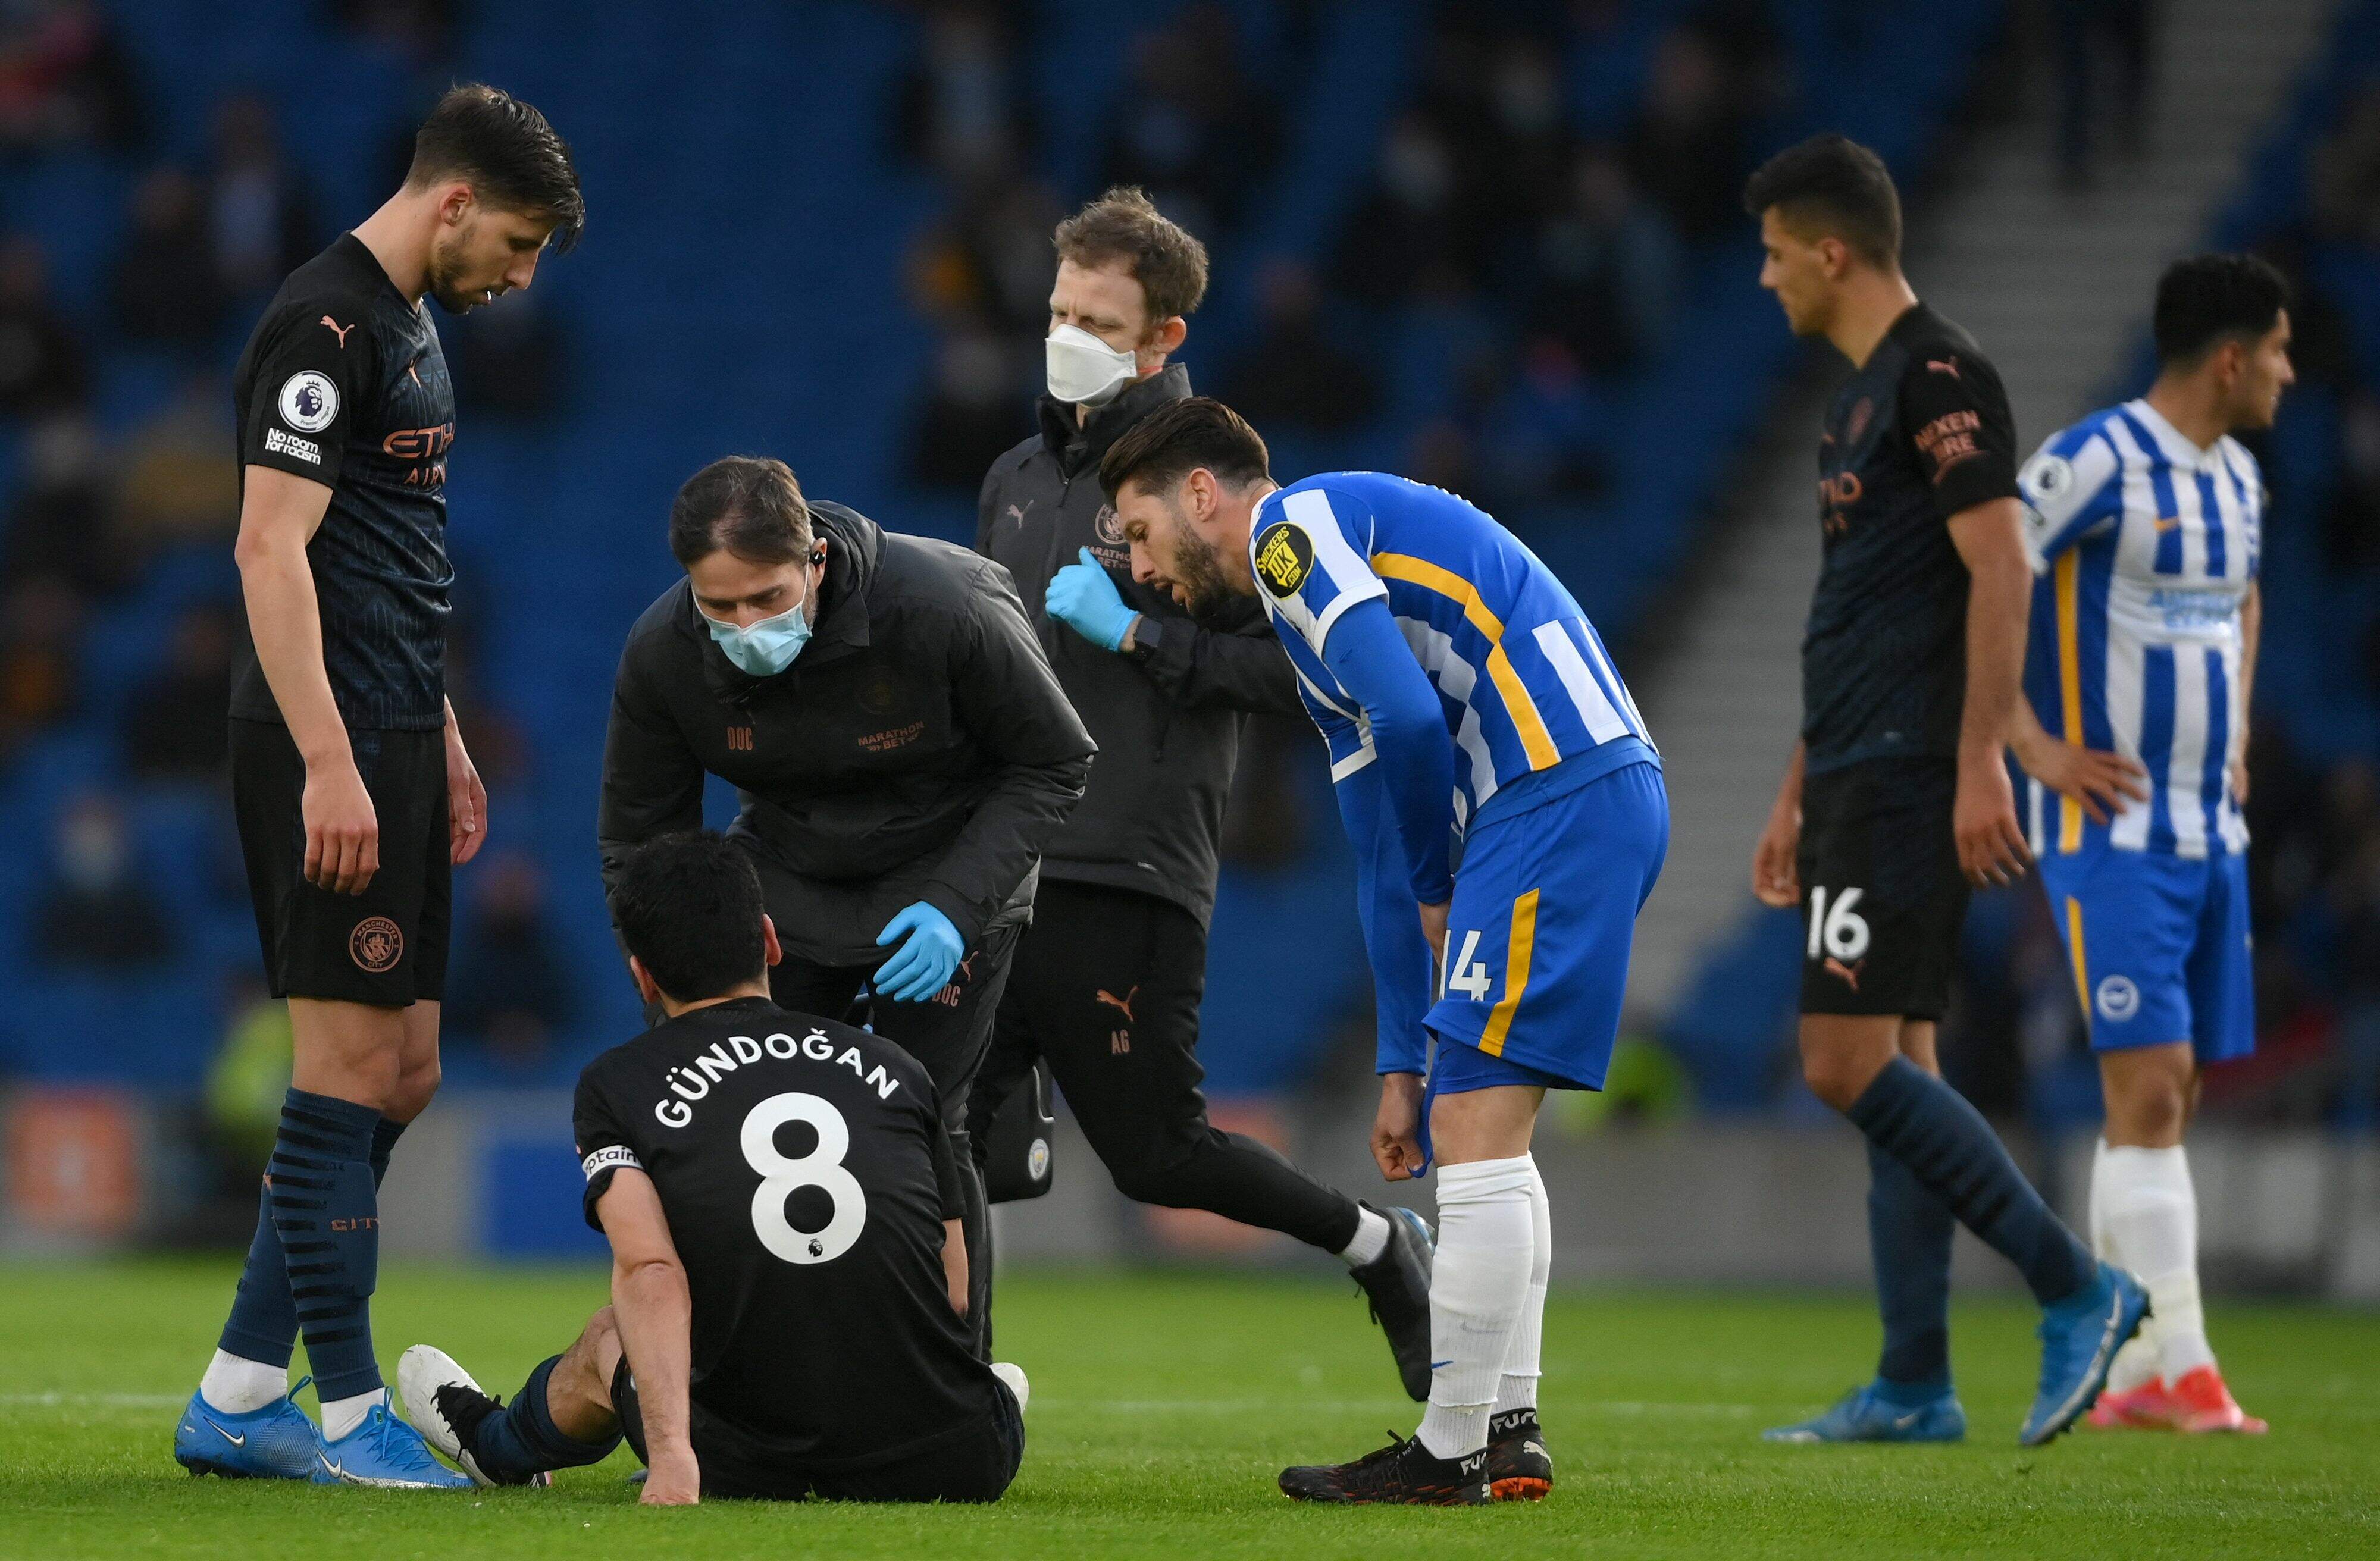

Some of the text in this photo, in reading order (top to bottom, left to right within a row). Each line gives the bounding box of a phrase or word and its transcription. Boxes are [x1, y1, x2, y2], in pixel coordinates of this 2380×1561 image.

[265, 438, 322, 466] for racism
[267, 427, 320, 454] No room
[1256, 526, 1291, 575] SNICKERS
[1271, 547, 1294, 579] UK
[726, 726, 753, 750] DOC
[857, 720, 925, 747] MARATHON
[882, 737, 906, 750] BET
[357, 920, 398, 939] MANCHESTER
[1807, 885, 1871, 961] 16
[1111, 1029, 1130, 1054] AG
[654, 1027, 900, 1129] GÜNDOĞAN
[585, 1146, 637, 1175] ptain
[740, 1092, 867, 1265] 8
